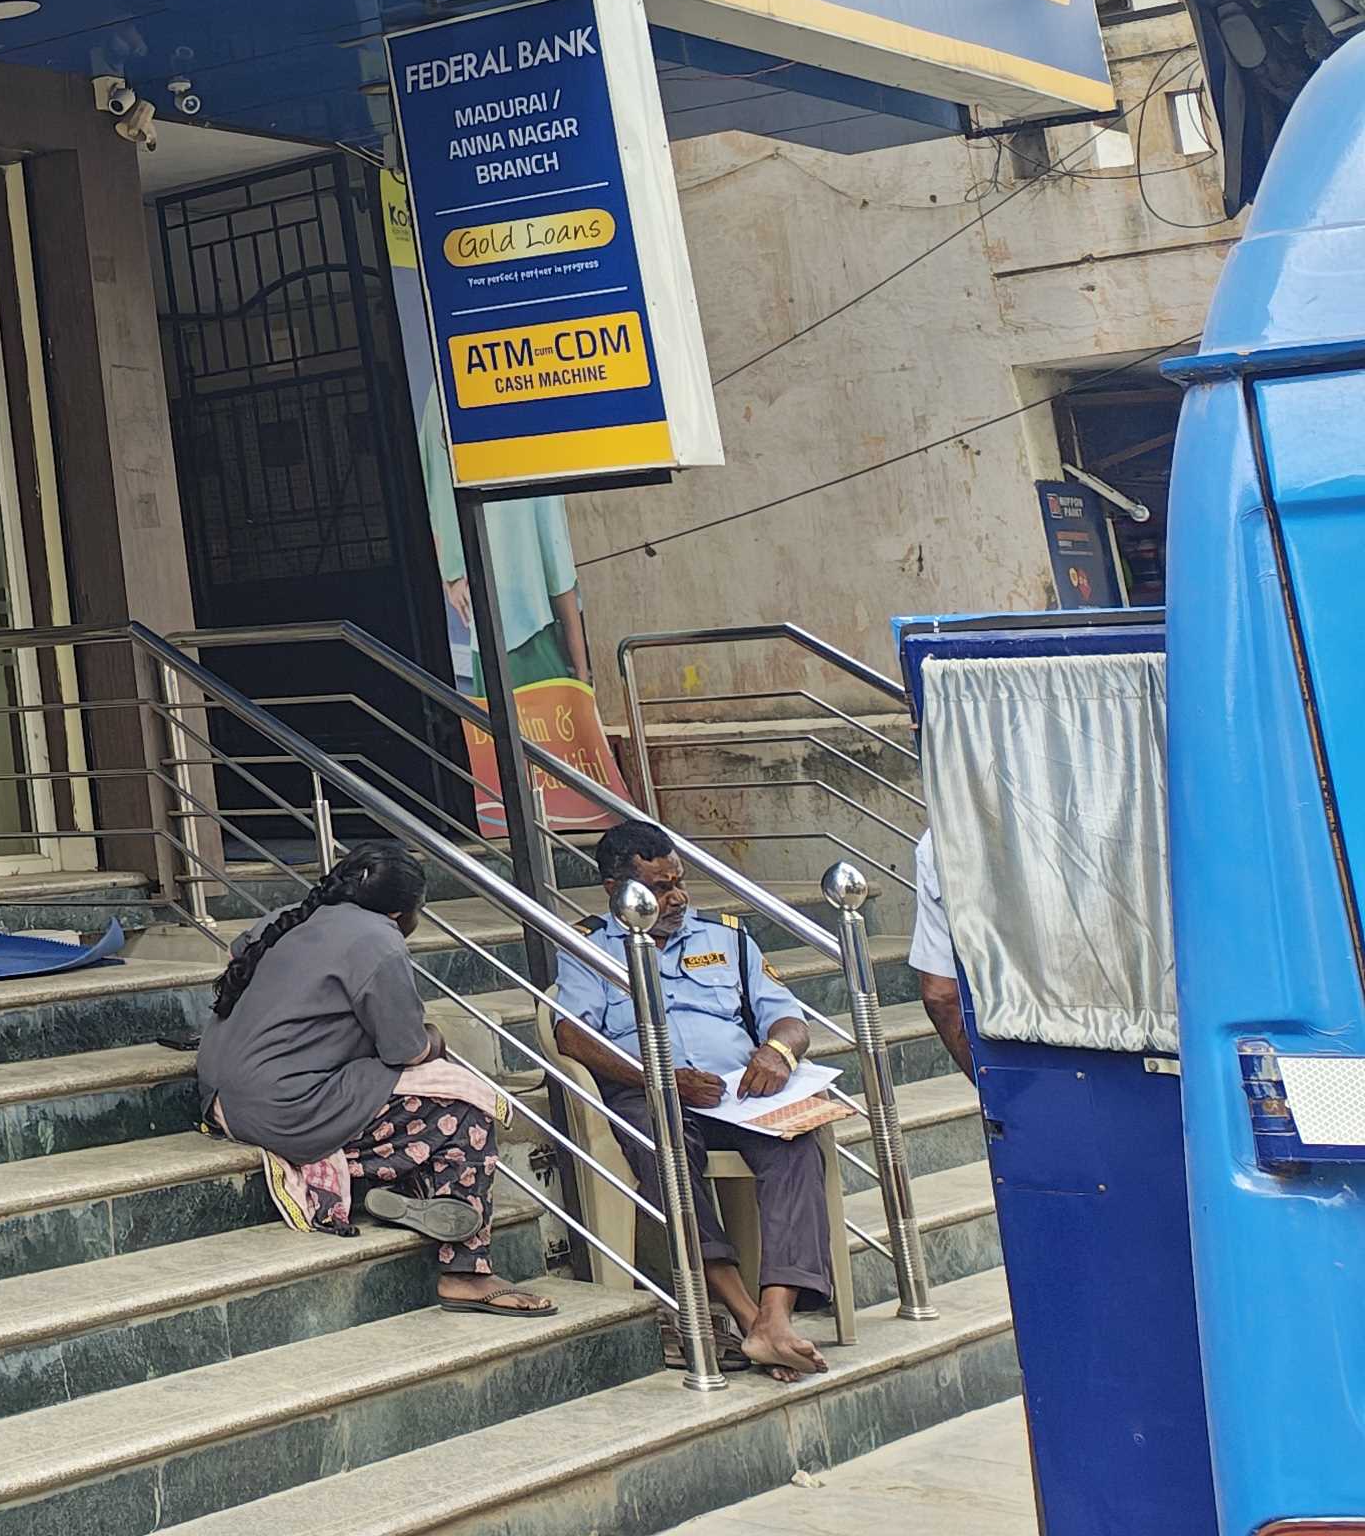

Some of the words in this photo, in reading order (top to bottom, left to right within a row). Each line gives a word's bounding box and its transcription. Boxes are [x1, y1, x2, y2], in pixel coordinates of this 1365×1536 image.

[405, 45, 512, 93] FEDERAL
[517, 25, 597, 72] BANK
[454, 92, 549, 129] MADURAI
[449, 131, 506, 161] ANNA
[508, 117, 579, 147] NAGAR
[476, 152, 560, 185] BRANCH
[458, 223, 515, 260] Gold
[524, 219, 604, 251] Loans
[467, 277, 486, 289] Your
[487, 271, 520, 288] perfect
[520, 267, 553, 281] partner
[563, 260, 599, 276] progress
[467, 338, 534, 375] ATM
[554, 324, 631, 362] CDM
[495, 375, 534, 393] CASH
[538, 365, 608, 388] MACHINE
